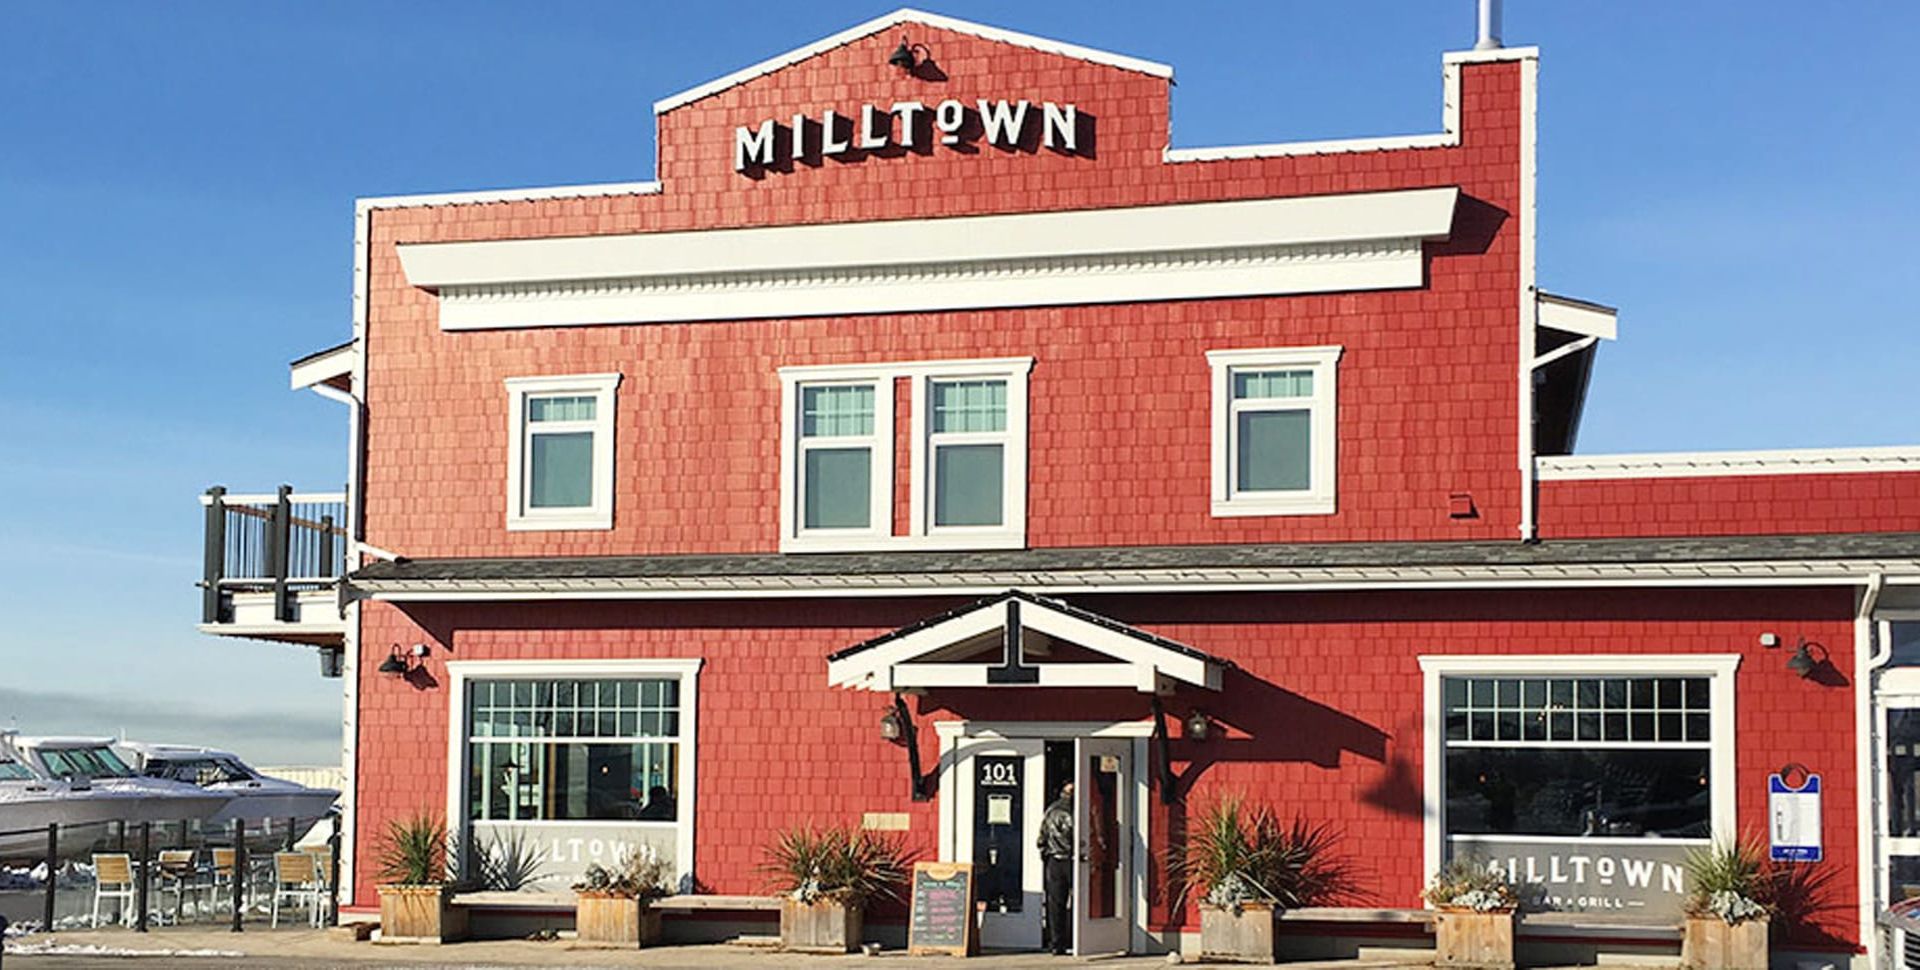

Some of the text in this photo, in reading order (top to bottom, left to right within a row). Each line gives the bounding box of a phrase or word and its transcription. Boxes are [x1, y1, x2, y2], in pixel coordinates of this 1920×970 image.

[735, 99, 1077, 171] MILLTOWN
[983, 763, 1015, 781] 101
[1578, 896, 1623, 909] GRILL
